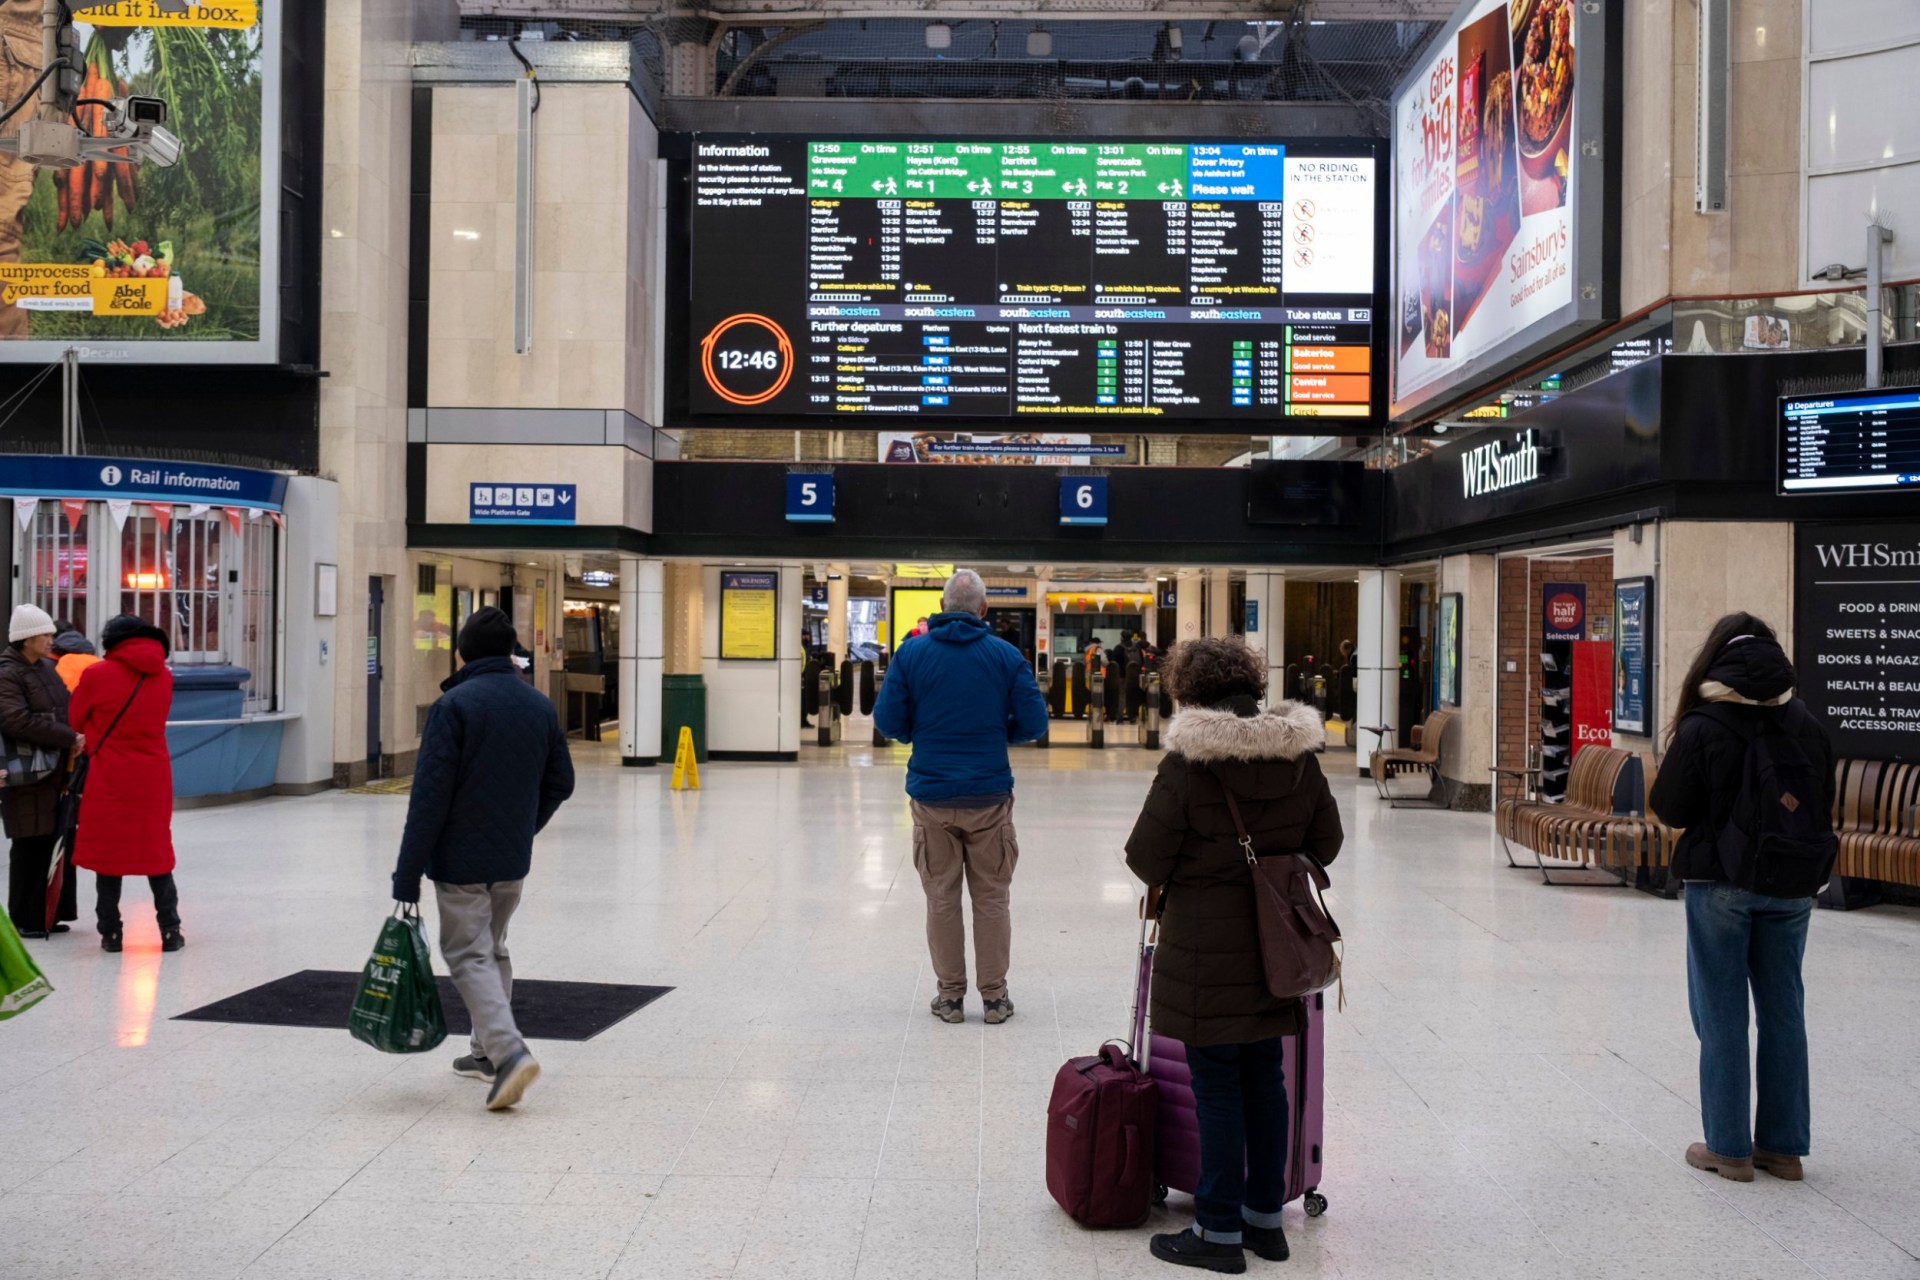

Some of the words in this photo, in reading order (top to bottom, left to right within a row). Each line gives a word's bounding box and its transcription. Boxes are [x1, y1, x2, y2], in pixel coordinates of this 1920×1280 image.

[126, 1, 142, 17] it
[198, 6, 243, 22] box.
[1430, 57, 1453, 104] Gifts
[1422, 95, 1450, 173] big
[699, 145, 769, 156] Information
[861, 145, 874, 153] On
[876, 145, 897, 153] time
[908, 145, 933, 153] 12:51
[956, 146, 969, 154] On
[971, 145, 992, 154] time
[1002, 146, 1030, 154] 12:55
[1051, 146, 1064, 154] On
[1066, 146, 1087, 154] time
[1098, 146, 1124, 154] 13:01
[1146, 147, 1160, 155] On
[1162, 147, 1182, 155] time
[1242, 147, 1256, 155] On
[1258, 147, 1278, 155] time
[907, 157, 932, 165] Hayes
[934, 157, 958, 166] (Kent)
[1097, 158, 1142, 166] Sevenoaks
[1192, 158, 1217, 166] Dover
[1219, 158, 1244, 168] Priory
[1299, 164, 1316, 172] NO
[1320, 164, 1358, 172] RIDING
[1412, 157, 1424, 189] for
[698, 176, 726, 184] security
[727, 176, 749, 184] please
[832, 179, 843, 192] 4
[906, 180, 922, 188] Plat
[928, 180, 934, 193] 1
[1002, 181, 1018, 189] Plat
[1022, 181, 1033, 193] 3
[1097, 181, 1113, 189] Plat
[1118, 181, 1128, 194] 2
[1192, 184, 1229, 195] Please
[1230, 185, 1255, 195] wait
[698, 187, 726, 195] luggage
[1511, 220, 1566, 283] Sainsbury's
[2, 267, 89, 281] unprocess
[8, 282, 49, 299] your
[54, 281, 91, 295] food
[1511, 288, 1523, 307] Good
[1524, 279, 1535, 297] food
[1536, 276, 1544, 290] for
[1553, 264, 1558, 280] of
[1560, 263, 1566, 276] us
[115, 285, 146, 297] Abel
[810, 307, 880, 317] southeastern
[905, 308, 975, 317] southeastern
[1000, 308, 1070, 318] southeastern
[1095, 309, 1166, 318] southeastern
[1190, 309, 1261, 319] southeastern
[1287, 310, 1310, 320] Tube
[1312, 310, 1341, 320] status
[811, 322, 849, 332] Further
[851, 322, 902, 333] depatures
[1018, 324, 1043, 333] Next
[1044, 324, 1079, 333] fastest
[1081, 324, 1105, 333] train
[1106, 325, 1118, 334] to
[1293, 334, 1311, 342] Good
[1312, 334, 1336, 342] service
[1293, 349, 1334, 358] Bakerloo
[719, 350, 777, 369] 12:46
[1293, 378, 1327, 386] Central
[1795, 401, 1834, 410] Departures
[1461, 428, 1537, 498] WHSmith
[131, 469, 160, 484] Rail
[164, 472, 240, 490] information
[801, 483, 817, 506] 5
[1076, 485, 1093, 509] 6
[817, 590, 824, 599] 5
[1168, 594, 1174, 603] 6
[1553, 607, 1576, 616] half
[1839, 603, 1874, 612] FOOD
[1878, 603, 1886, 612] &
[1827, 629, 1876, 638] SWEETS
[1880, 629, 1887, 638] &
[1818, 655, 1861, 664] BOOKS
[1864, 655, 1872, 664] &
[1827, 681, 1874, 690] HEALTH
[1878, 681, 1885, 691] &
[1828, 707, 1875, 716] DIGITAL
[1879, 708, 1886, 717] &
